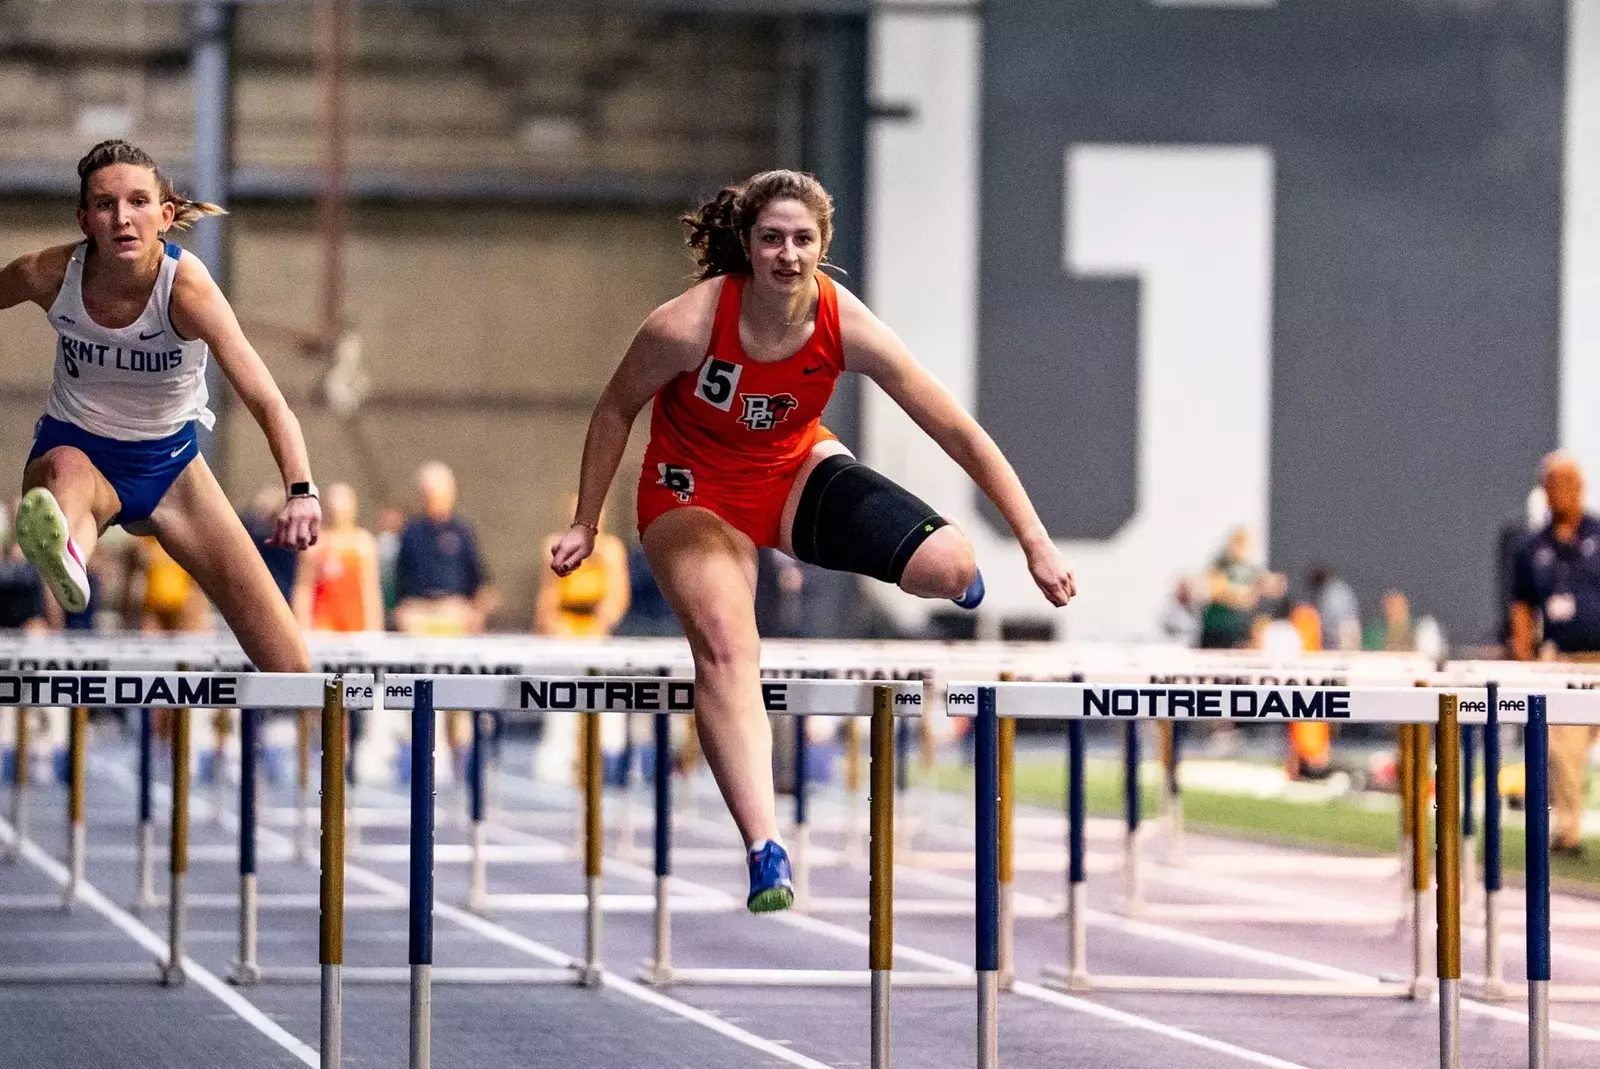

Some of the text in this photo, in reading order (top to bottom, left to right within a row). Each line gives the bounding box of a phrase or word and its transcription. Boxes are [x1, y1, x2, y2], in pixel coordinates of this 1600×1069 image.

[116, 348, 182, 372] LOUIS
[702, 358, 736, 404] 5
[115, 677, 237, 705] DAME
[520, 681, 787, 711] NOTRE DE
[1083, 689, 1350, 719] NOTRE DAME
